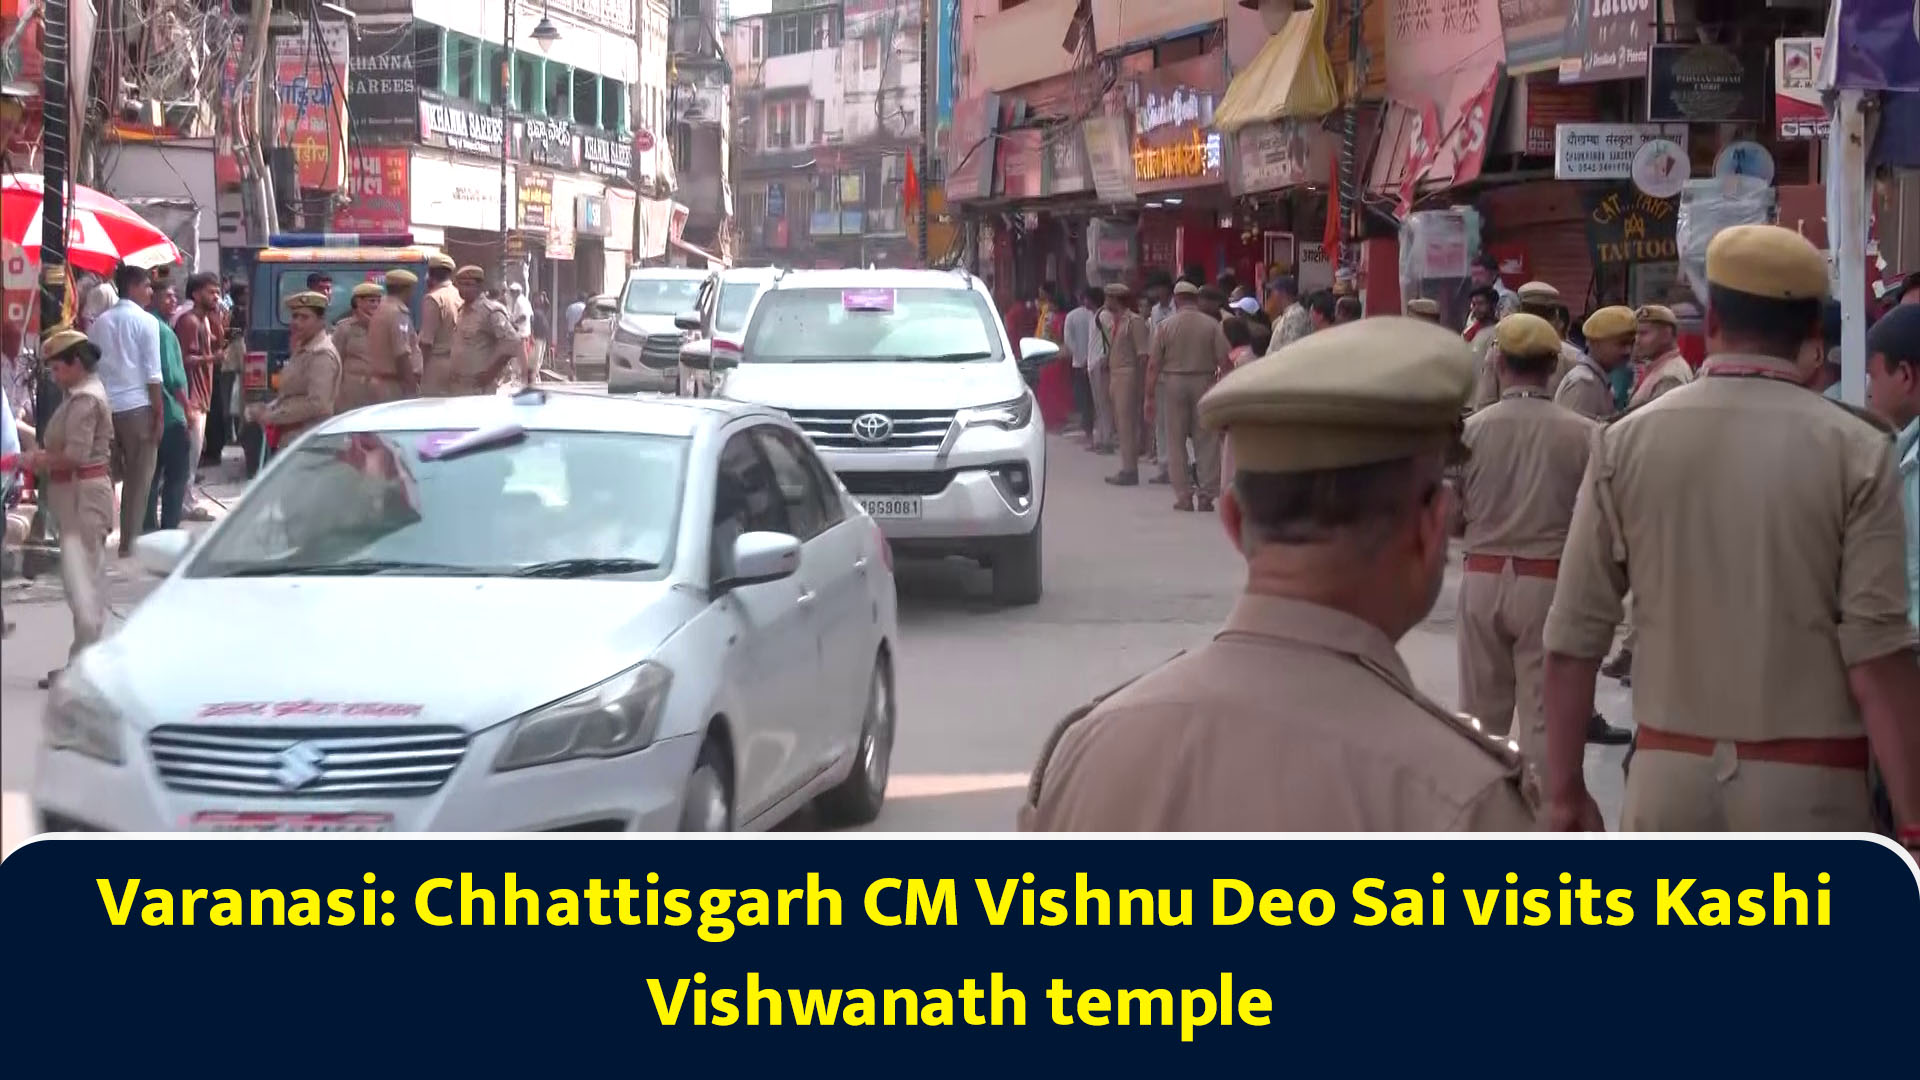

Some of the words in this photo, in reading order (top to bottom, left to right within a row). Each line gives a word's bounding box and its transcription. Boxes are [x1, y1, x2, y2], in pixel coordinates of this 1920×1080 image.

[429, 105, 469, 137] KHANNA
[468, 112, 503, 143] SAREES
[1597, 240, 1676, 262] TATTOO
